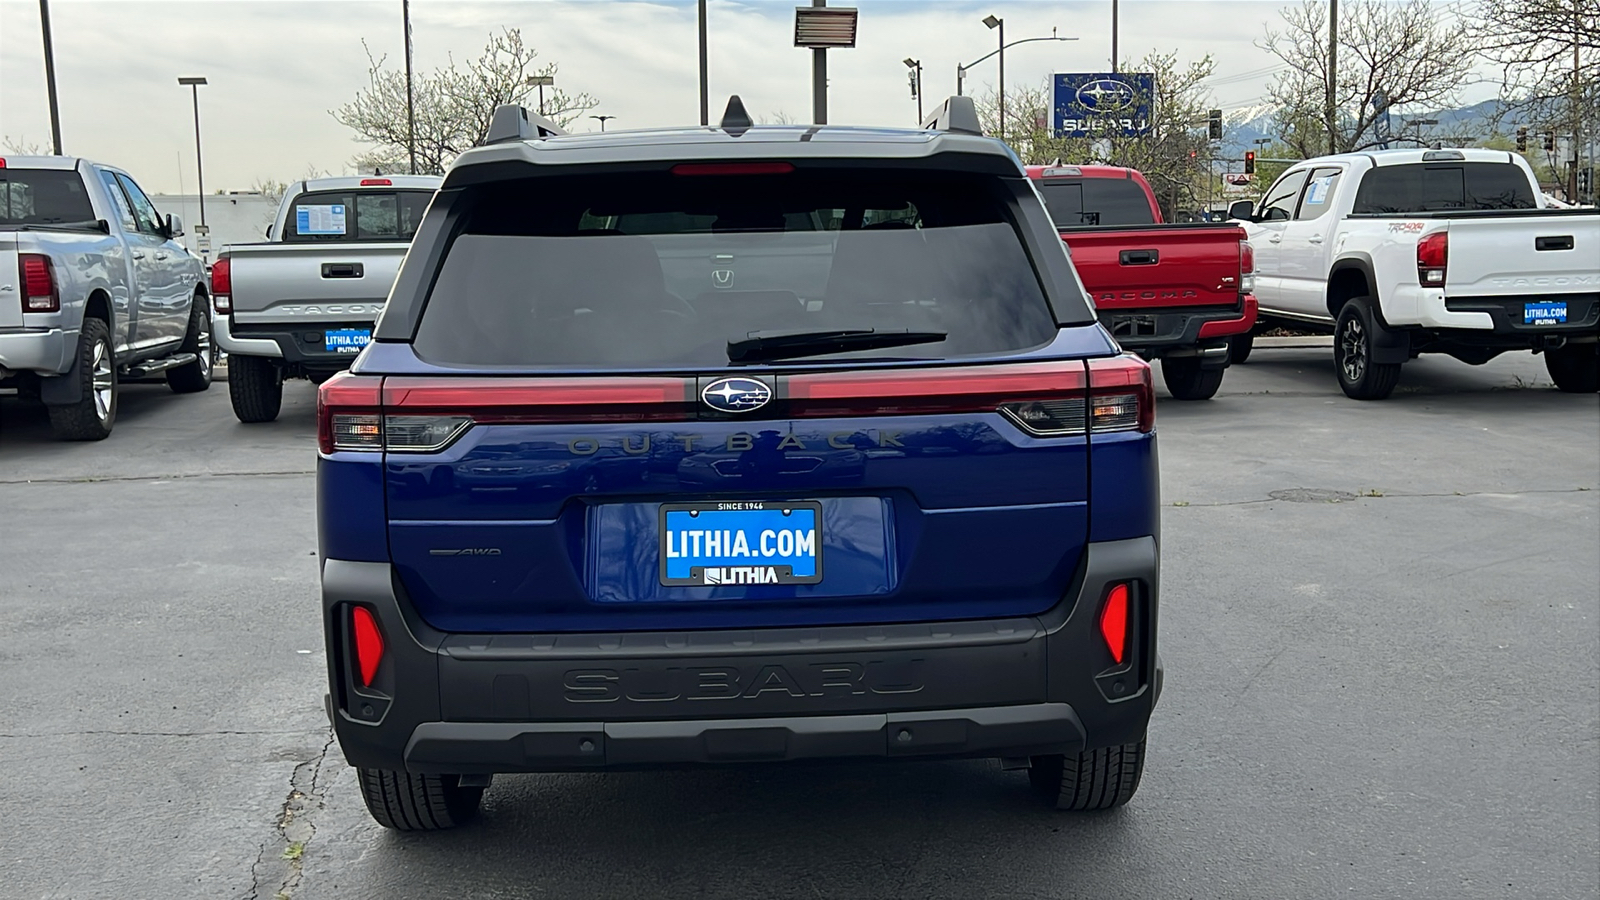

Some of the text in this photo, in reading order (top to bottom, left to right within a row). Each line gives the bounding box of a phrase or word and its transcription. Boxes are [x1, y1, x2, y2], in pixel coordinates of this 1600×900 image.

[1492, 276, 1600, 288] TACOM
[1094, 289, 1198, 300] ACOMA
[282, 304, 386, 315] TACOM
[1524, 308, 1567, 318] LITHIA.COM
[326, 335, 370, 345] LITHIA.COM
[567, 430, 905, 455] OUTBACK
[745, 502, 763, 510] 1946
[666, 529, 815, 558] LITHIA.COM
[457, 548, 502, 556] AWD
[721, 566, 778, 584] LITHIA
[563, 659, 925, 703] SUBARU
